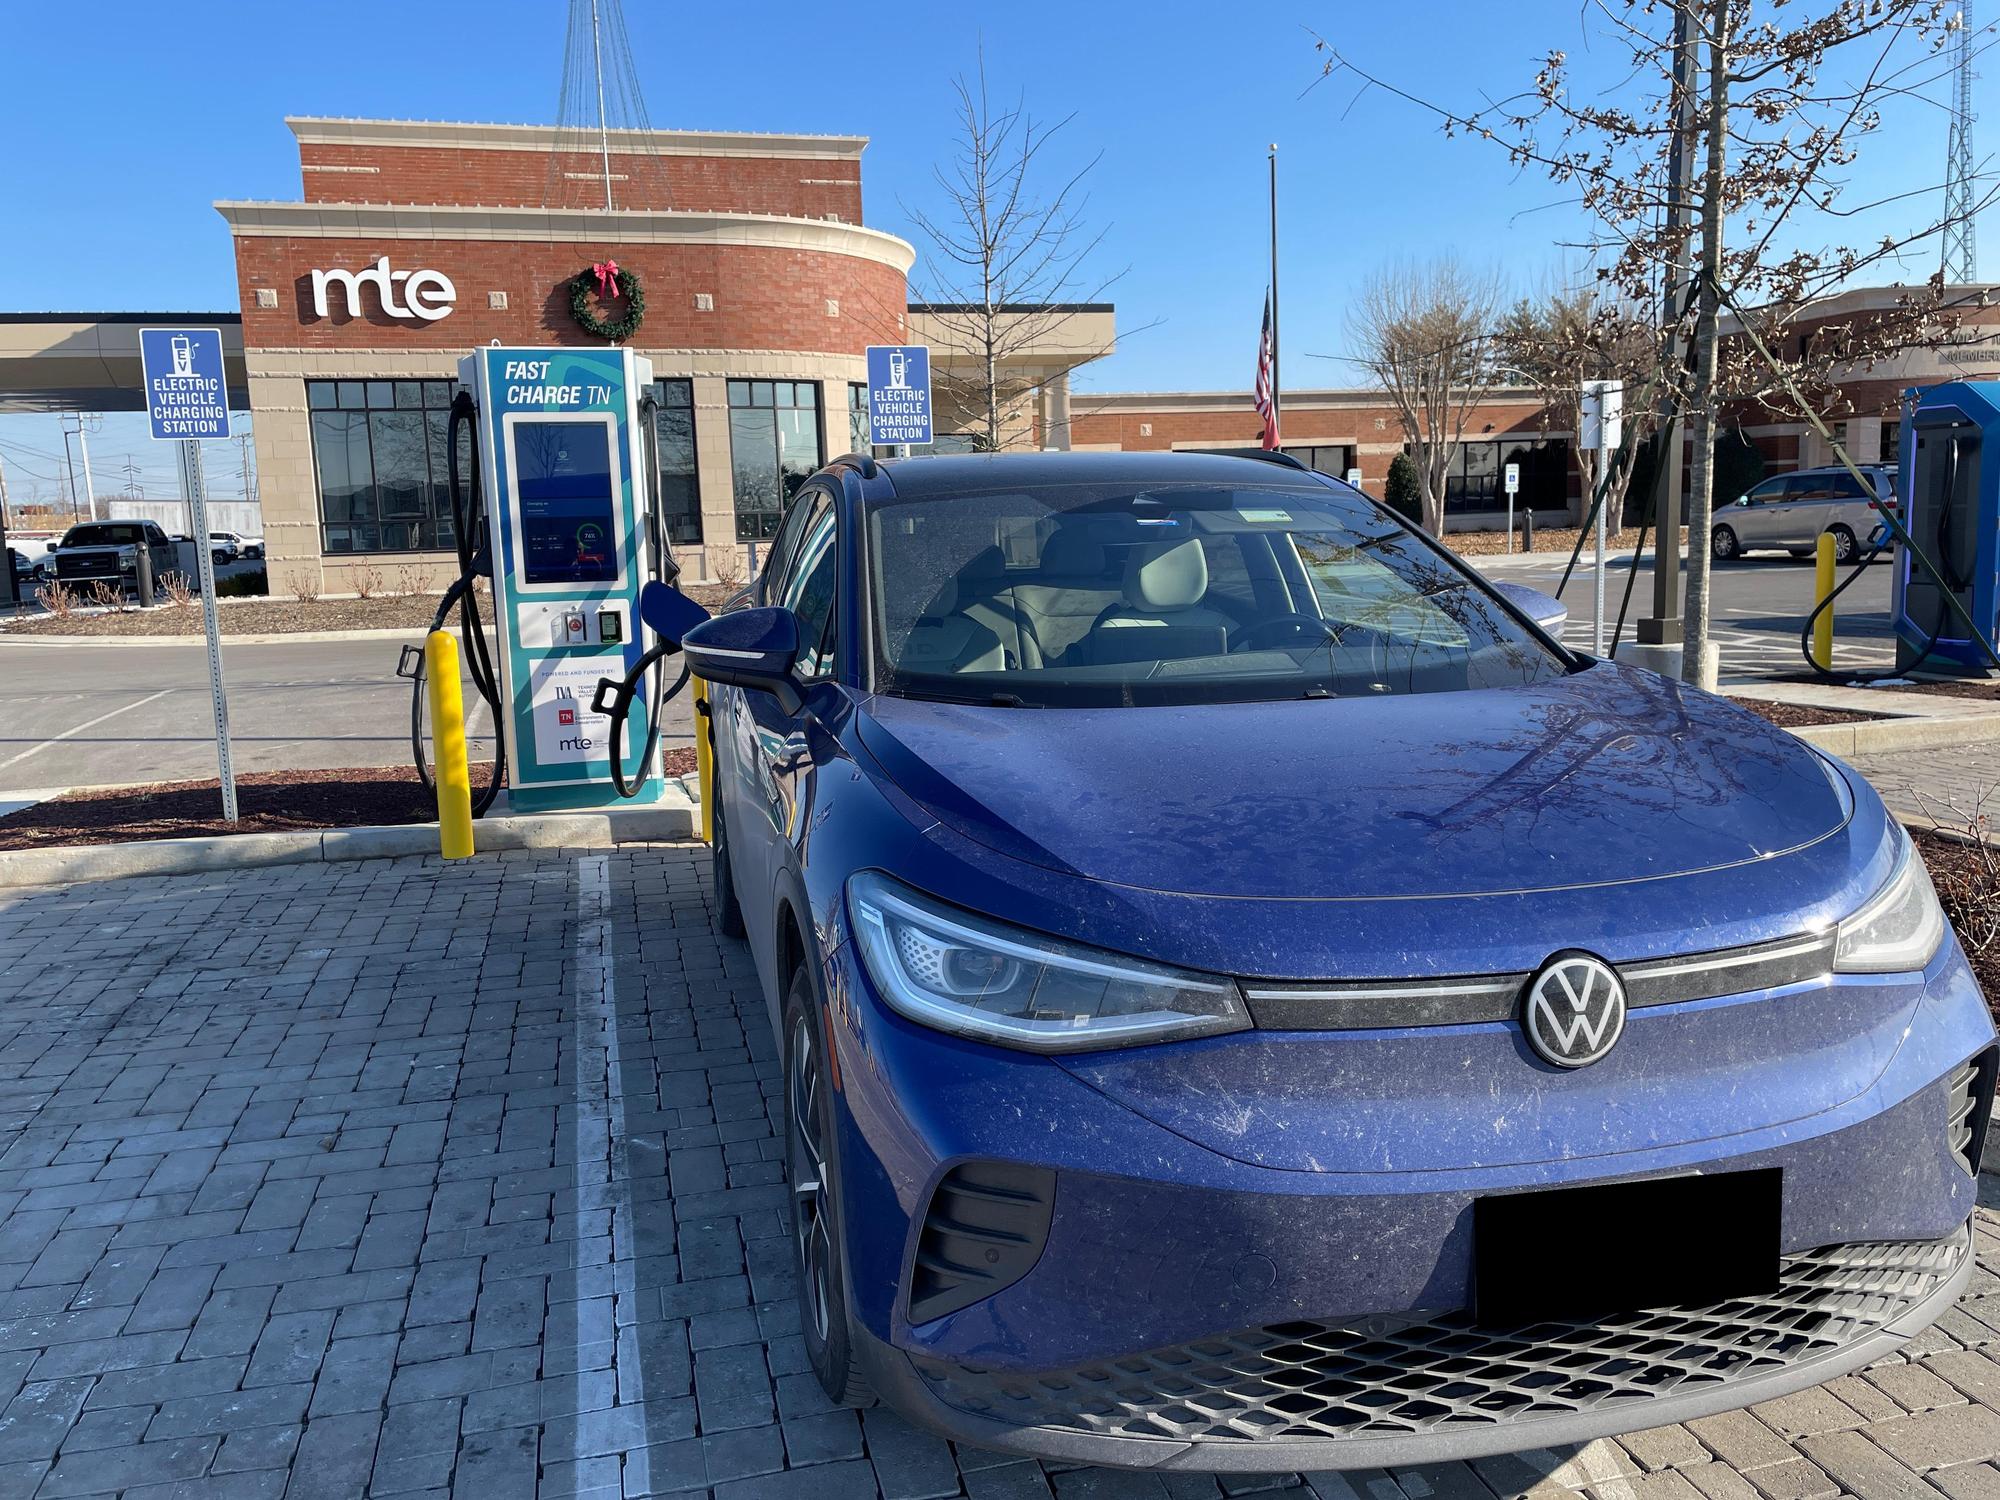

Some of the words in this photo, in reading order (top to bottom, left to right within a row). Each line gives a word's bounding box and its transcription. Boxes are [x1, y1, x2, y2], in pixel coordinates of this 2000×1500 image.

[311, 255, 457, 321] mte
[505, 361, 551, 380] FAST
[153, 378, 219, 391] ELECTRIC
[159, 392, 216, 405] VEHICLE
[507, 385, 581, 405] CHARGE
[587, 386, 611, 405] TN
[874, 390, 925, 401] ELECTRIC
[153, 406, 224, 419] CHARGING
[878, 402, 923, 413] VEHICLE
[163, 420, 218, 433] STATION
[873, 415, 928, 426] CHARGING
[880, 427, 923, 439] STATION
[555, 686, 572, 699] TVA
[560, 736, 592, 750] mte
